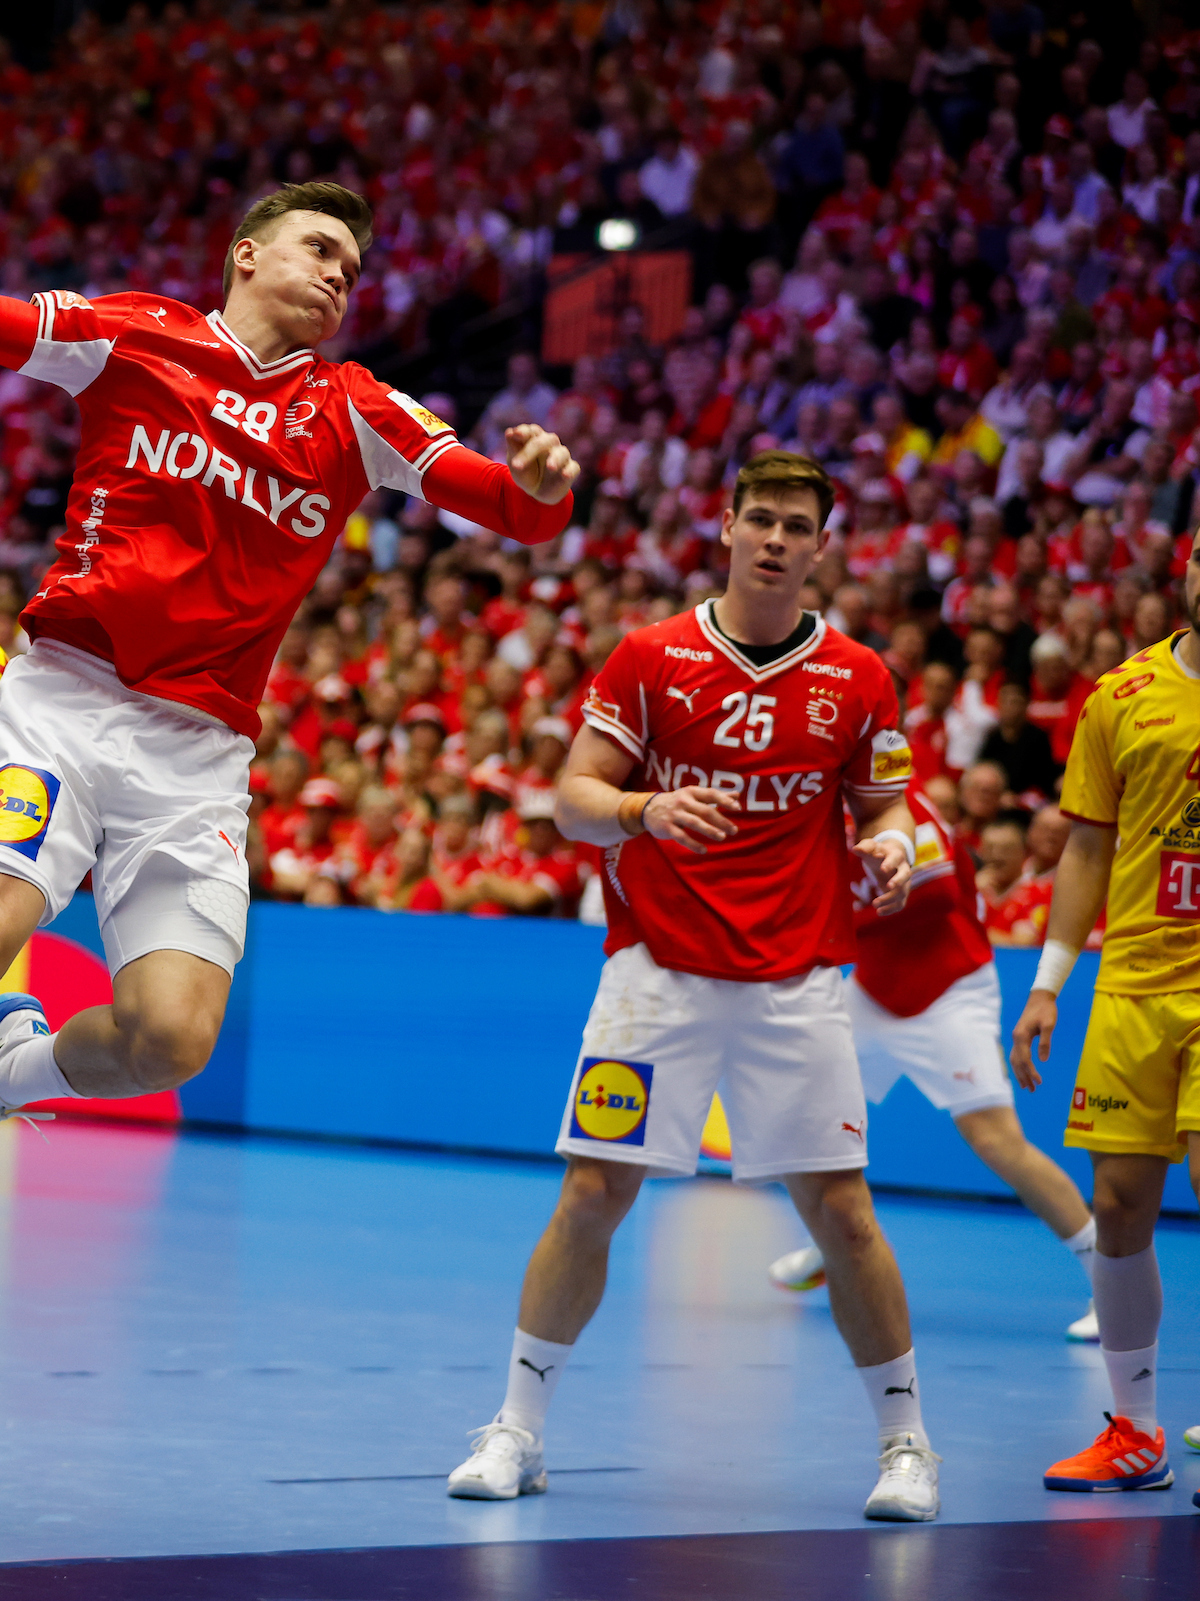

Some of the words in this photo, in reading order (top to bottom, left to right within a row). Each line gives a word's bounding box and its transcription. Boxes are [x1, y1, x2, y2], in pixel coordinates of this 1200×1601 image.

[210, 388, 278, 443] 28
[124, 424, 331, 539] NORLYS
[664, 644, 714, 662] NORLYS
[802, 661, 852, 680] NORLYS
[713, 691, 777, 752] 25
[1149, 826, 1200, 839] ALKA
[1088, 1095, 1129, 1112] triglav
